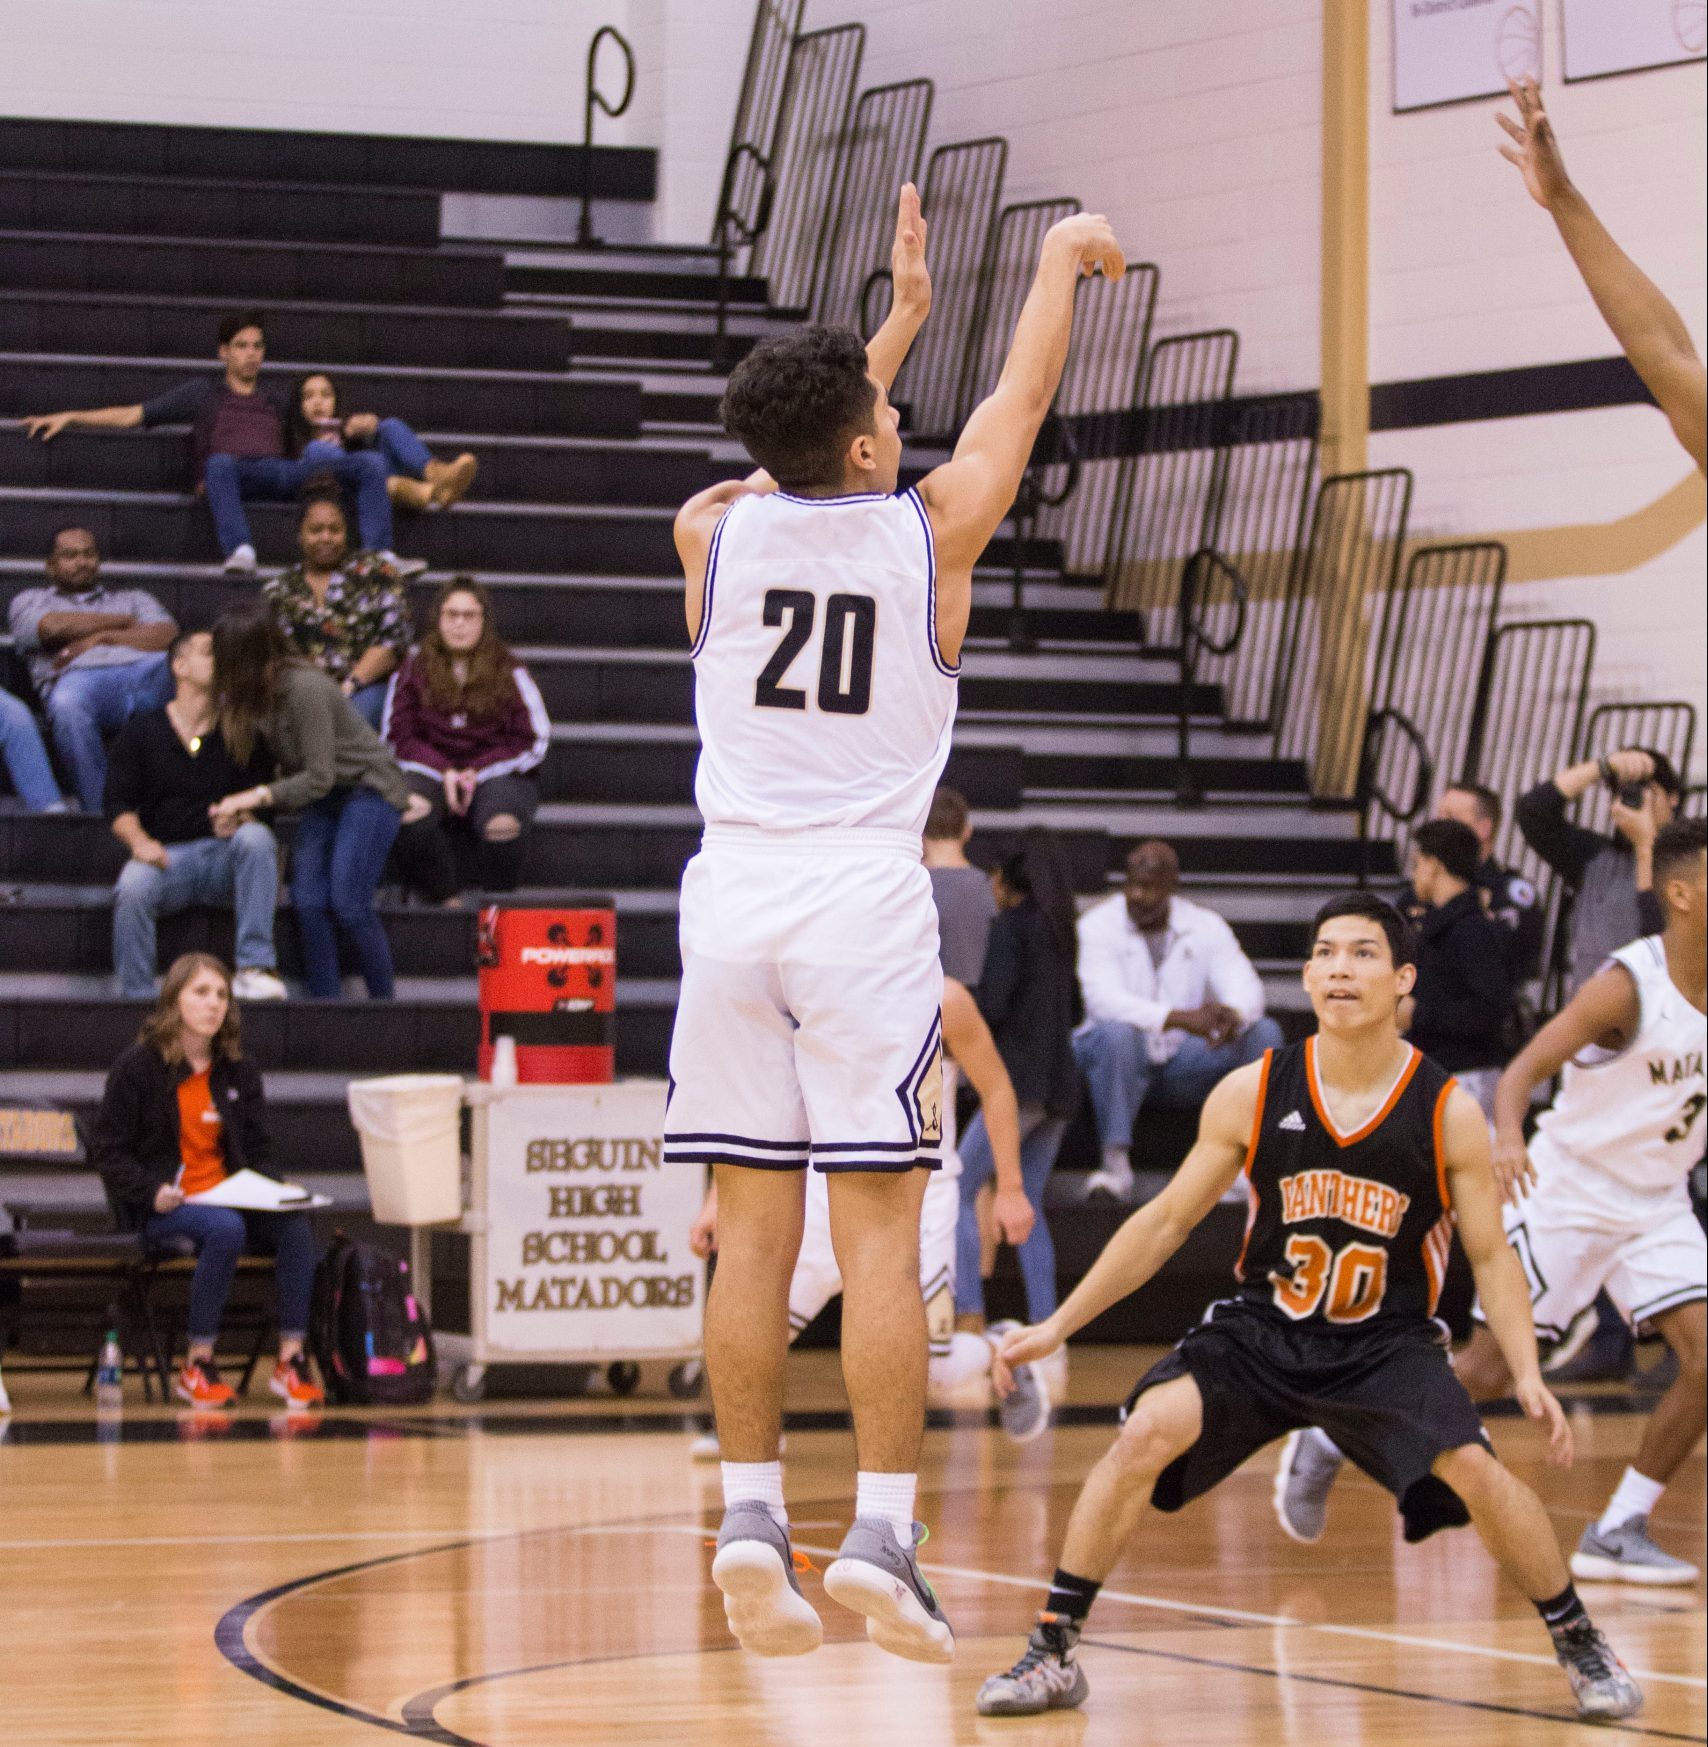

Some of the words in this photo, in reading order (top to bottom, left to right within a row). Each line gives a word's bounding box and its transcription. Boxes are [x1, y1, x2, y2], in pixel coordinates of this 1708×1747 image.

[754, 587, 878, 716] 20
[526, 1138, 662, 1174] SEGUIN
[548, 1184, 643, 1219] HIGH
[522, 1229, 668, 1268] SCHOOL
[496, 1274, 695, 1312] MATADORS
[1267, 1233, 1389, 1323] 30
